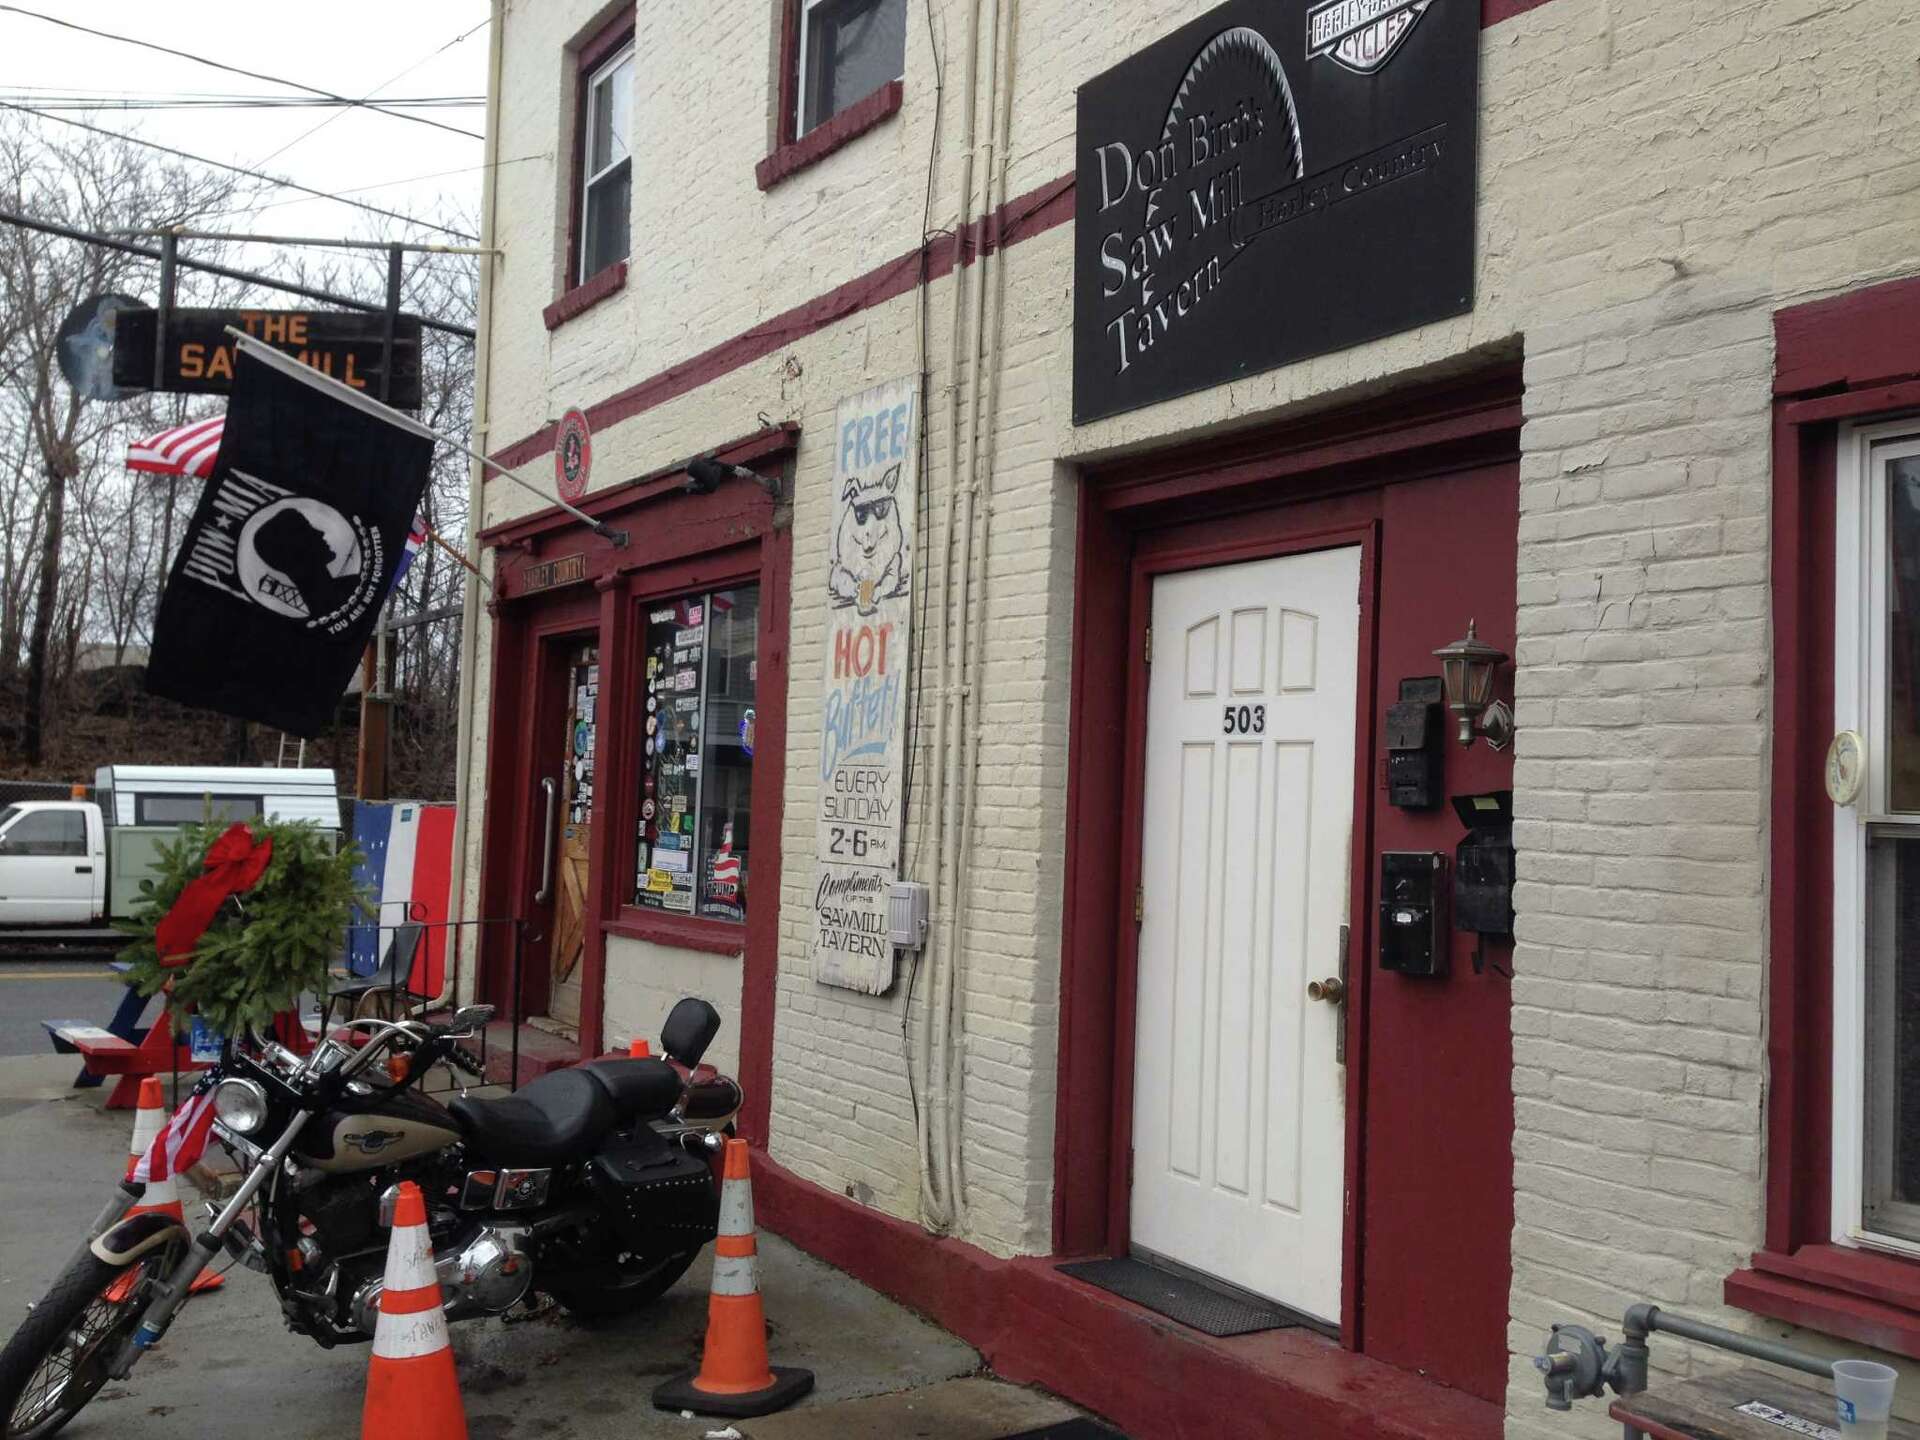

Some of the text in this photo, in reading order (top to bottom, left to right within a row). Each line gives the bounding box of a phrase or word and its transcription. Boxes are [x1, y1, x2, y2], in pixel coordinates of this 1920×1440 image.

[1343, 8, 1408, 60] CYCLES
[1094, 138, 1178, 213] Don
[1100, 163, 1244, 297] Saw Mill
[240, 311, 308, 345] THE
[1106, 254, 1222, 377] Tavern
[841, 403, 908, 473] FREE
[327, 525, 384, 635] YOU ARE NOT FORGOTTEN
[833, 623, 893, 679] HOT
[1223, 704, 1266, 734] 503
[834, 769, 891, 794] EVERY
[824, 796, 894, 821] SUNDAY
[830, 827, 868, 857] 2-6
[820, 906, 888, 936] SAWMILL
[819, 928, 887, 959] TAVERN
